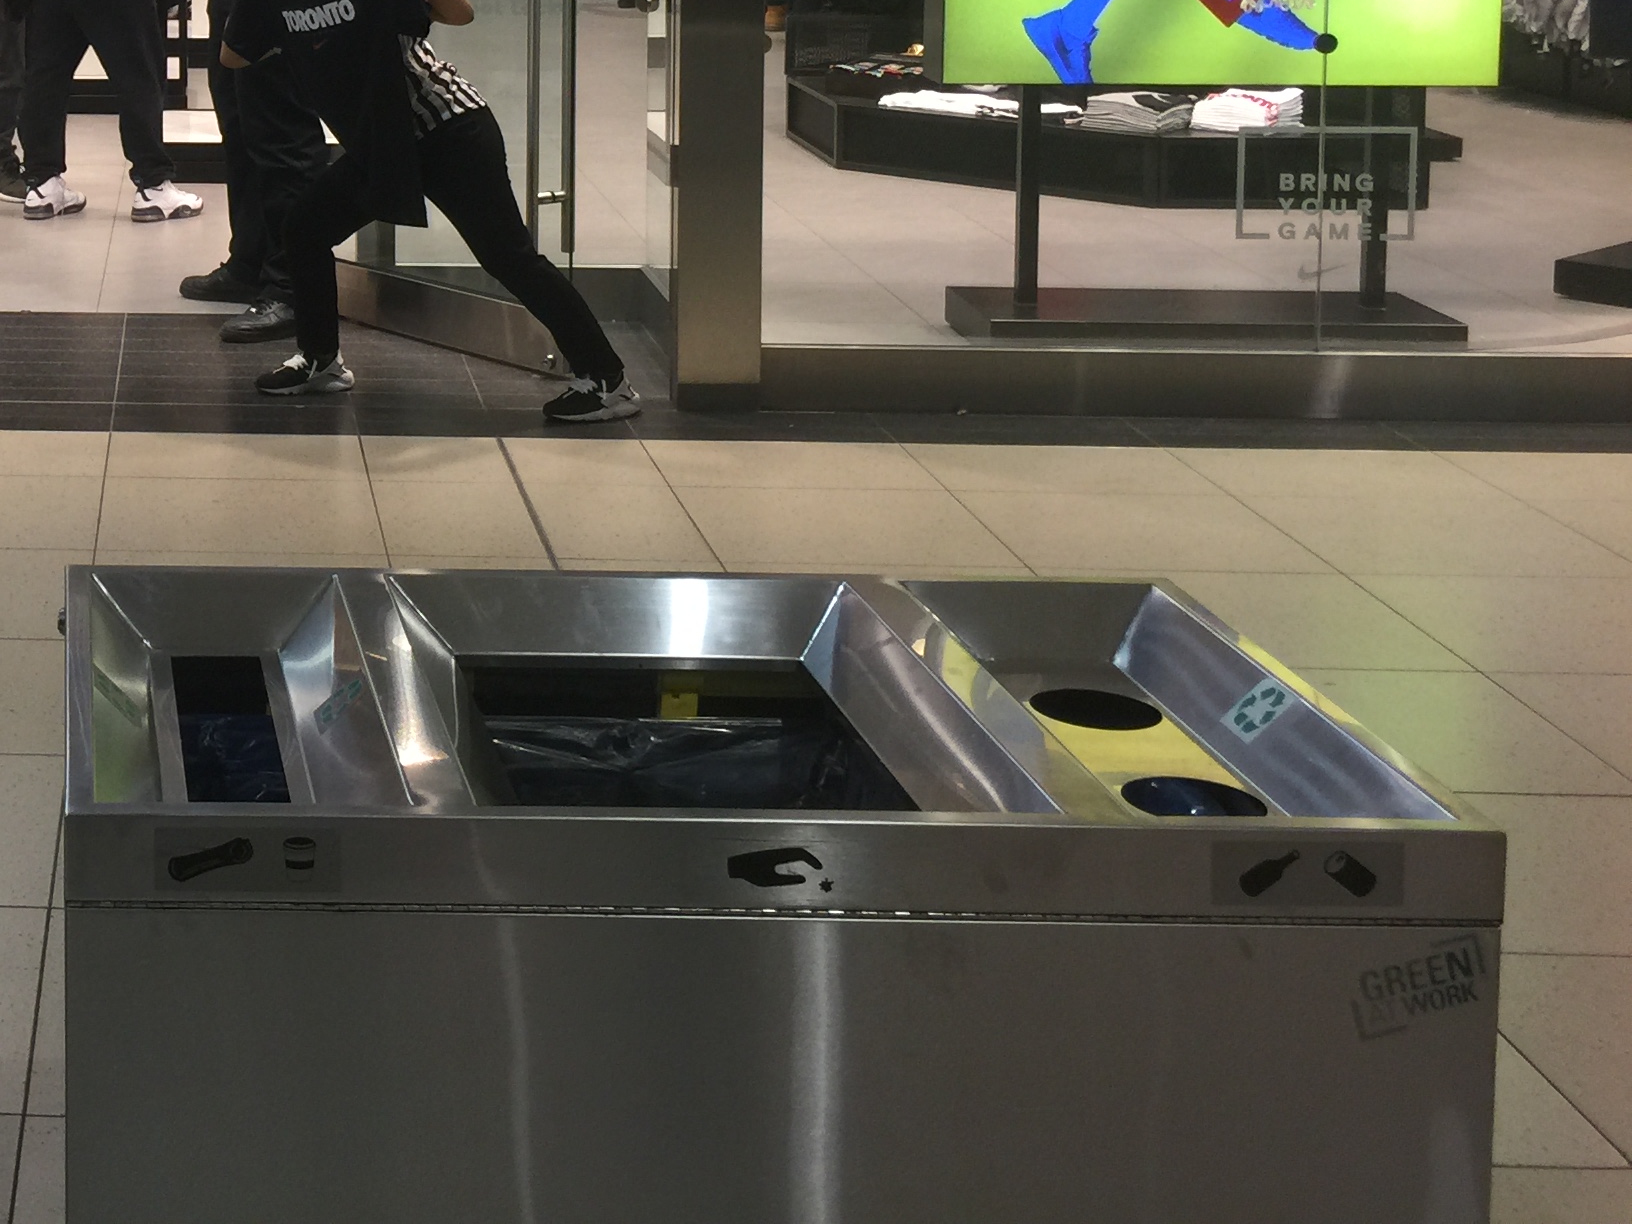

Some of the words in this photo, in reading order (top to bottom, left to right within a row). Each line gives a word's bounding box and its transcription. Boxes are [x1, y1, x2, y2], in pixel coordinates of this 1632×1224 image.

[1279, 173, 1374, 192] BRING
[1278, 197, 1373, 216] YOUR
[1278, 222, 1372, 241] GAME
[1359, 947, 1474, 1001] GREEN
[1402, 980, 1479, 1016] WORK
